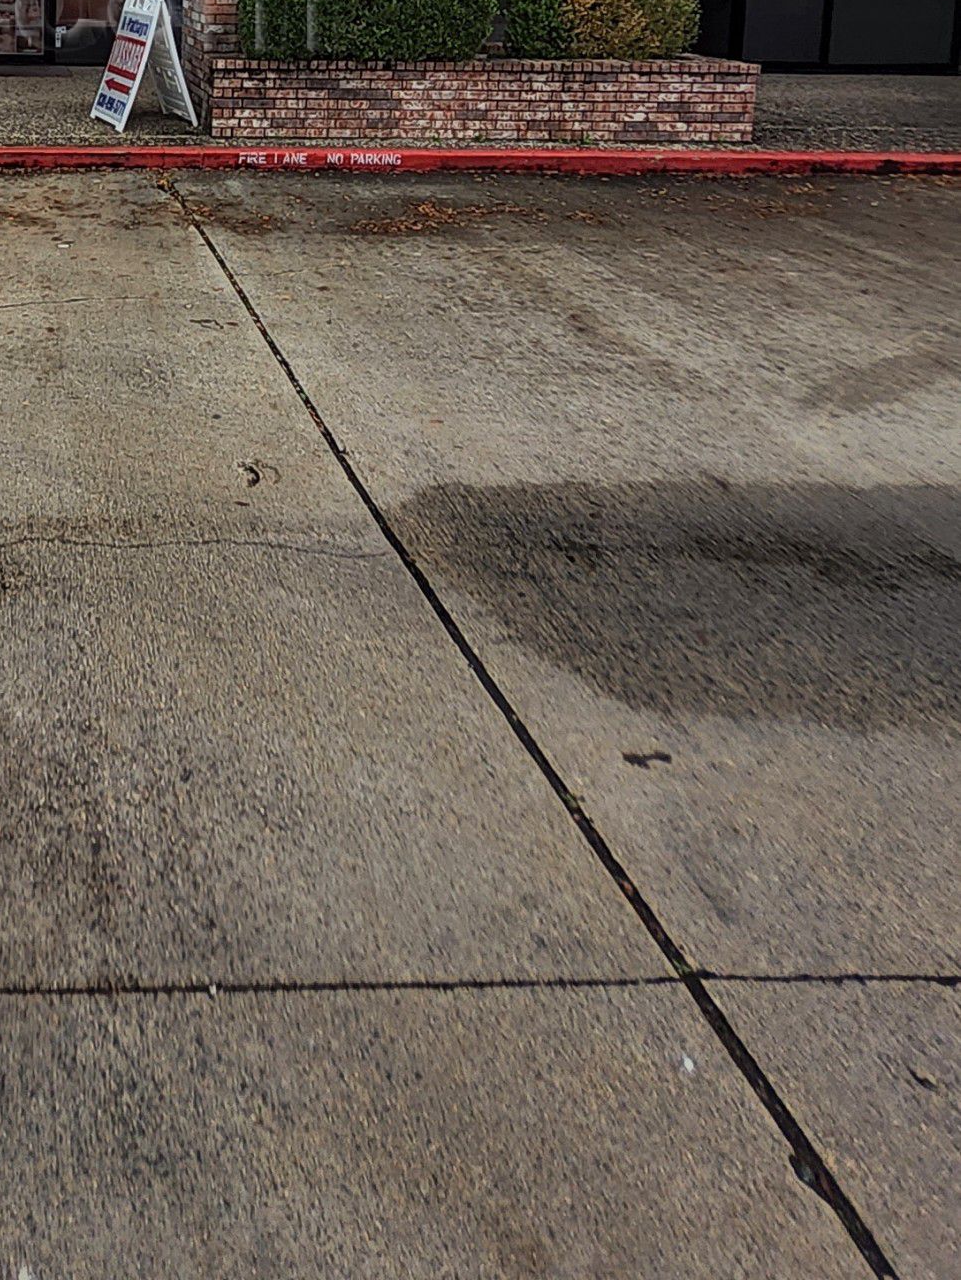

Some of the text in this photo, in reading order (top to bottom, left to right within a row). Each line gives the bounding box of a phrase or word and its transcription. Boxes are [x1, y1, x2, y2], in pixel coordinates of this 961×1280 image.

[238, 152, 267, 164] FIRE
[326, 153, 344, 165] NO
[350, 153, 402, 165] PARKING
